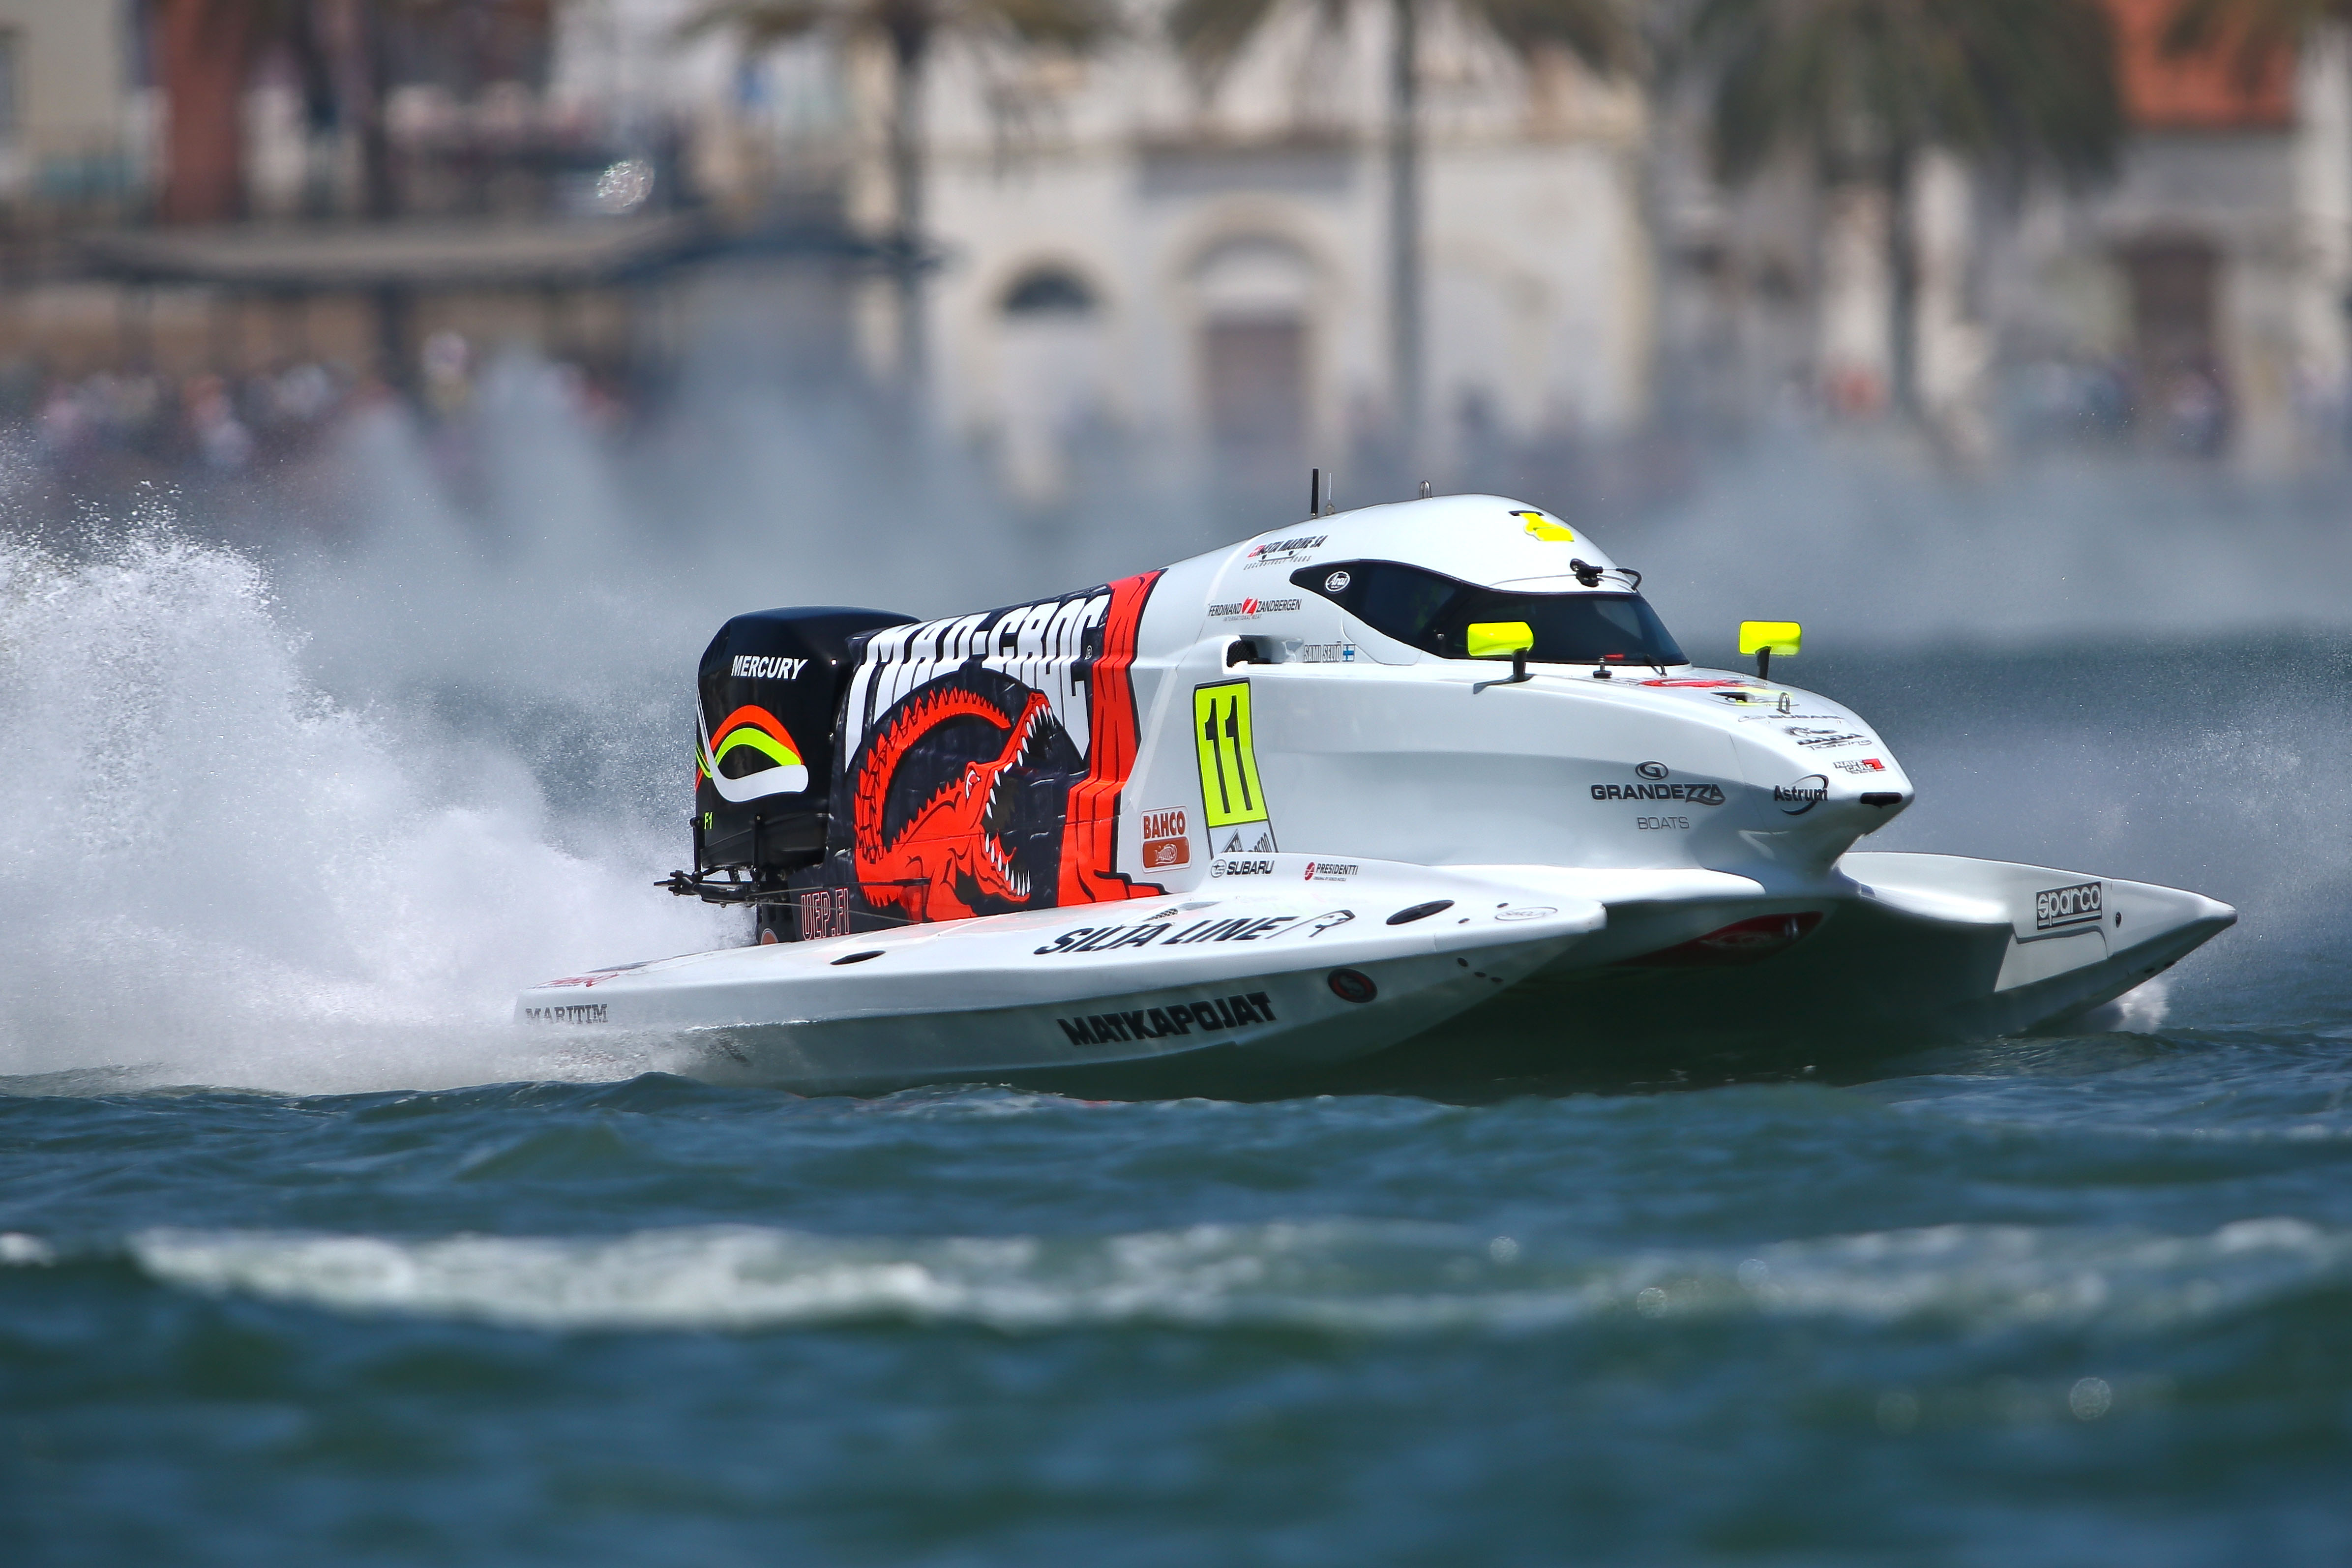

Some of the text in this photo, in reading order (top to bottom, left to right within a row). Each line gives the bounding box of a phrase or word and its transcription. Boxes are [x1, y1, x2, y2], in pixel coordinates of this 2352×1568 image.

[1328, 573, 1347, 586] Arai
[1208, 598, 1302, 617] FERDINAND ZANDBERGEN
[1304, 644, 1322, 662] SAMI
[731, 654, 808, 680] MERCURY
[1204, 694, 1253, 814] 11
[1806, 740, 1873, 751] Racing
[1590, 783, 1726, 806] GRANDEZZA
[1773, 785, 1828, 801] Astrum
[704, 811, 713, 830] F1
[1143, 810, 1186, 839] BAHCO
[1637, 817, 1690, 830] BOATS
[1226, 860, 1275, 875] SUBARU
[1316, 863, 1359, 875] PRESIDENTTI
[801, 887, 850, 941] UEP.FI
[2037, 885, 2101, 926] sparco
[1033, 916, 1301, 955] SILJA LINE
[525, 1003, 609, 1025] MARITIM
[1057, 991, 1278, 1046] MATKAPOJAT
